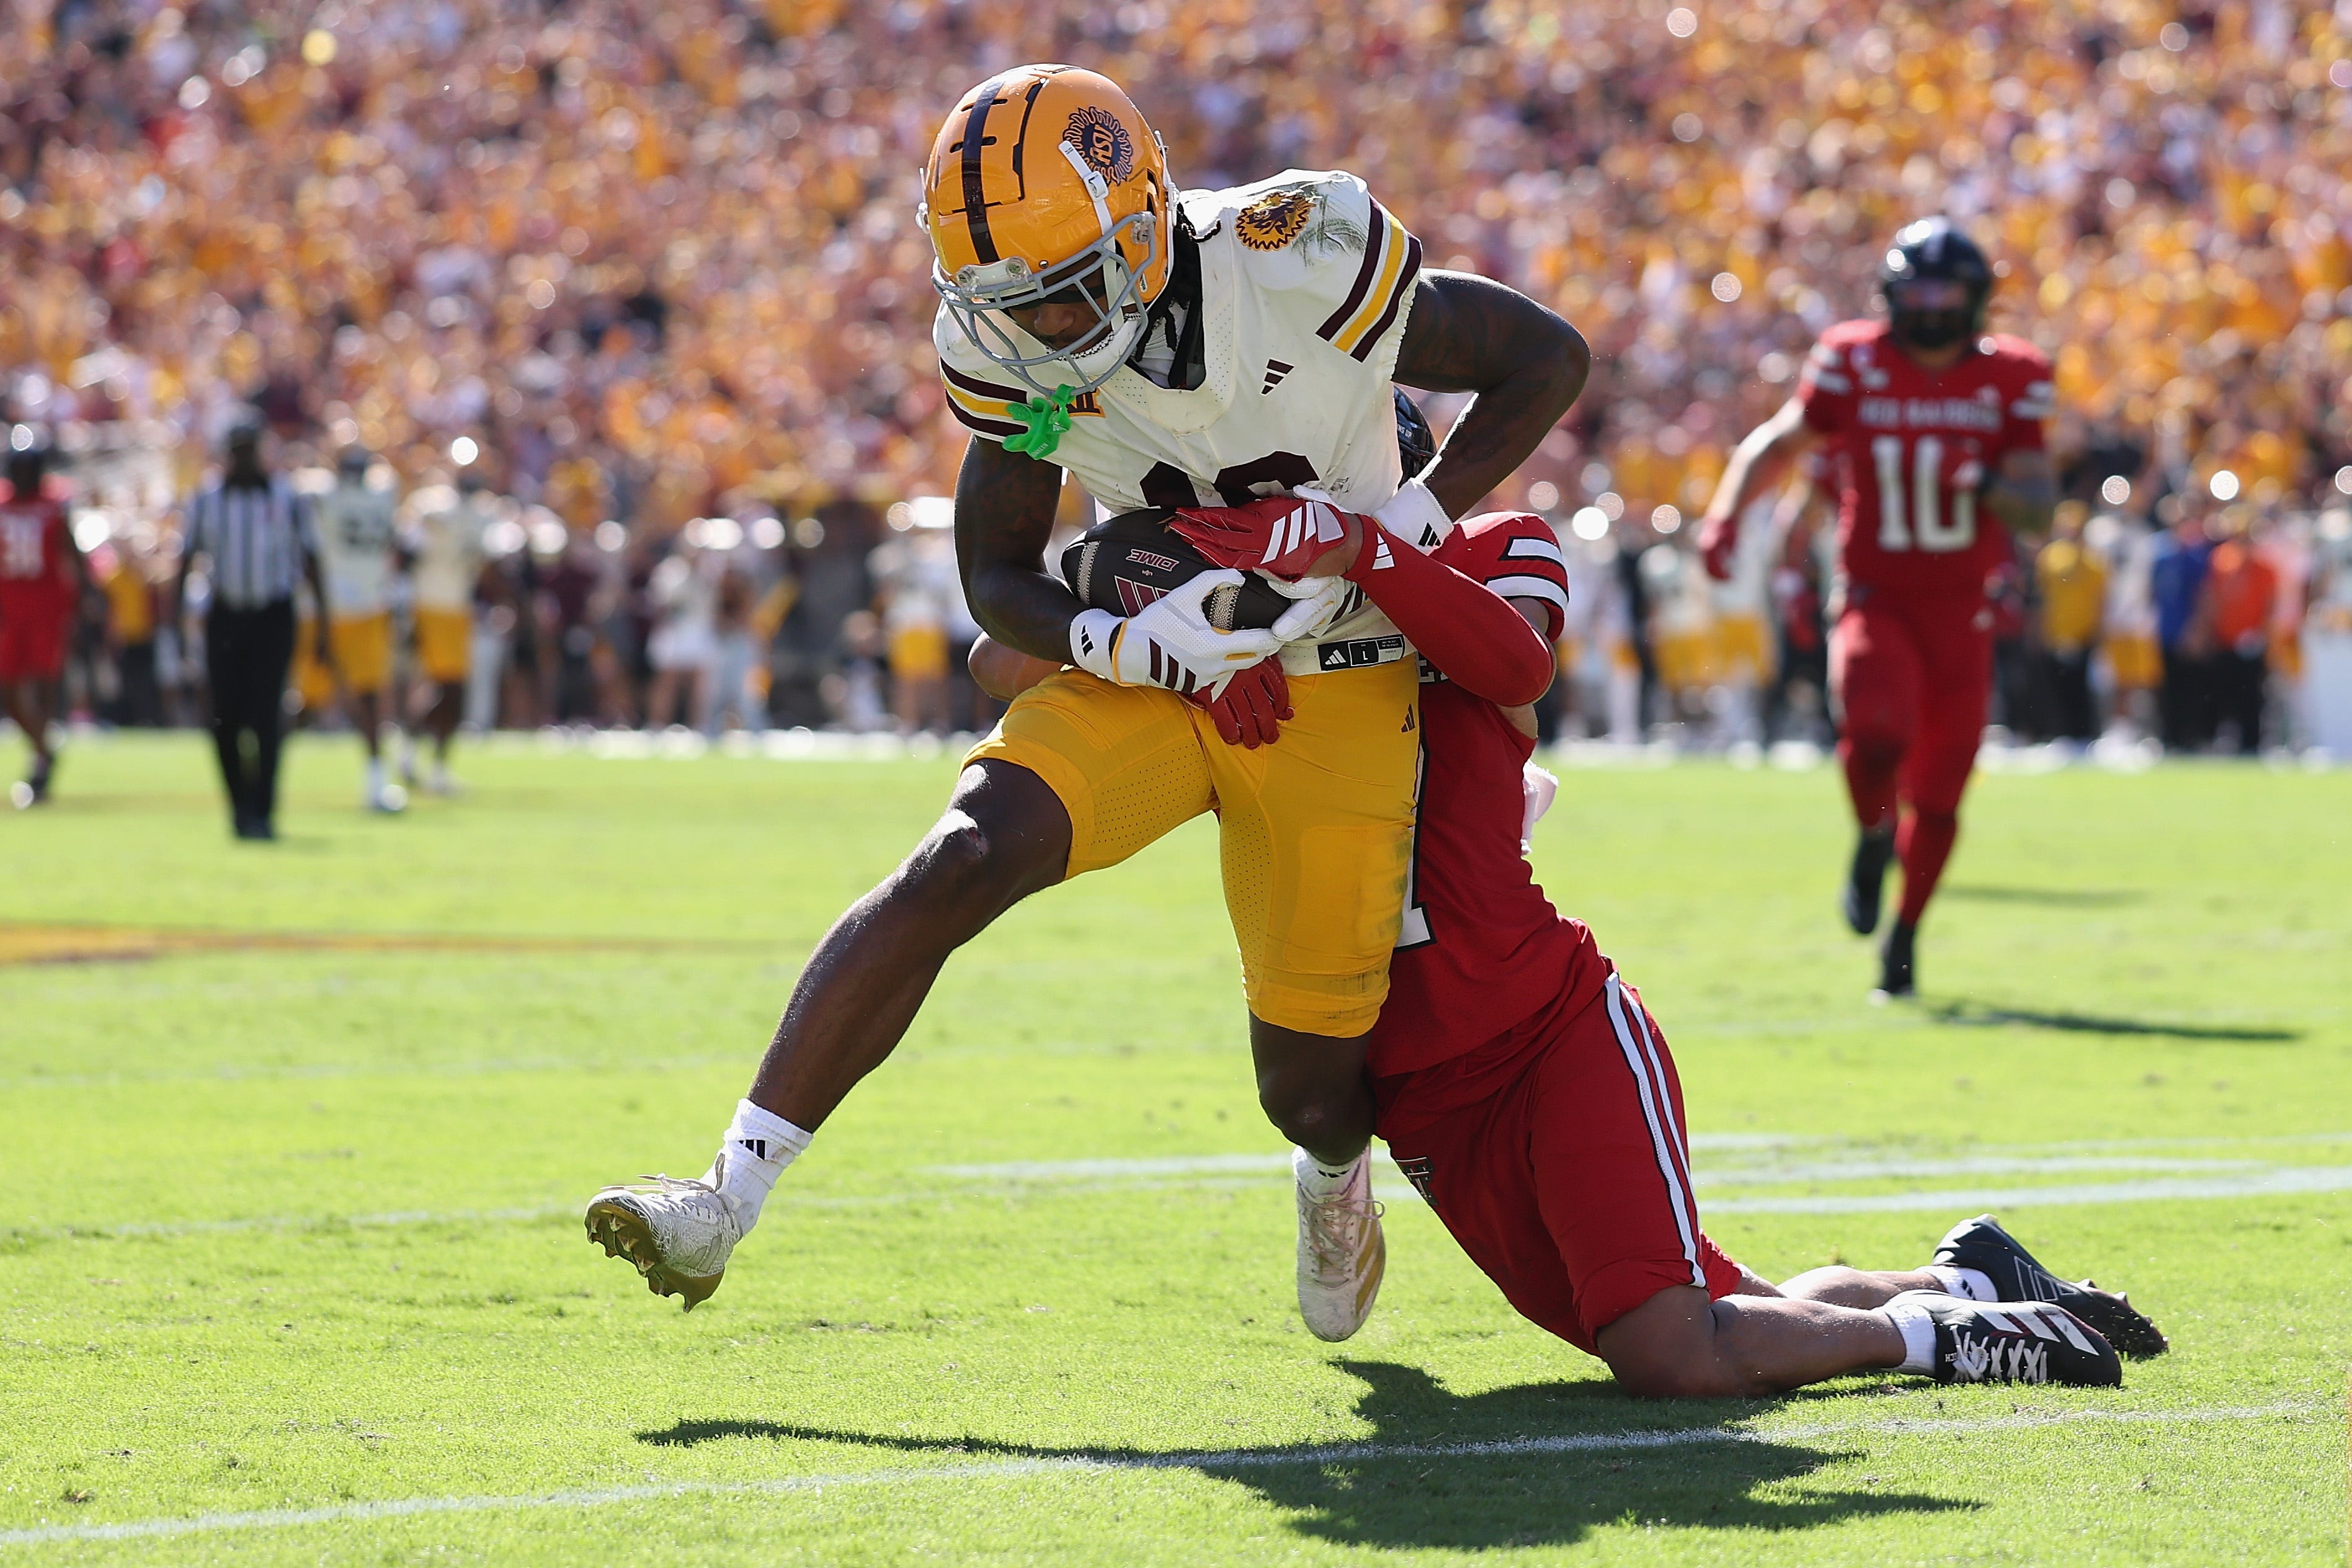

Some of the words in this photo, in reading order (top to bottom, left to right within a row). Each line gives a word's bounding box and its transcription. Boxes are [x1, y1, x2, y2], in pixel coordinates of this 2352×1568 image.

[1090, 124, 1114, 166] ASU
[1126, 548, 1180, 572] DIME
[1363, 651, 1368, 661] L
